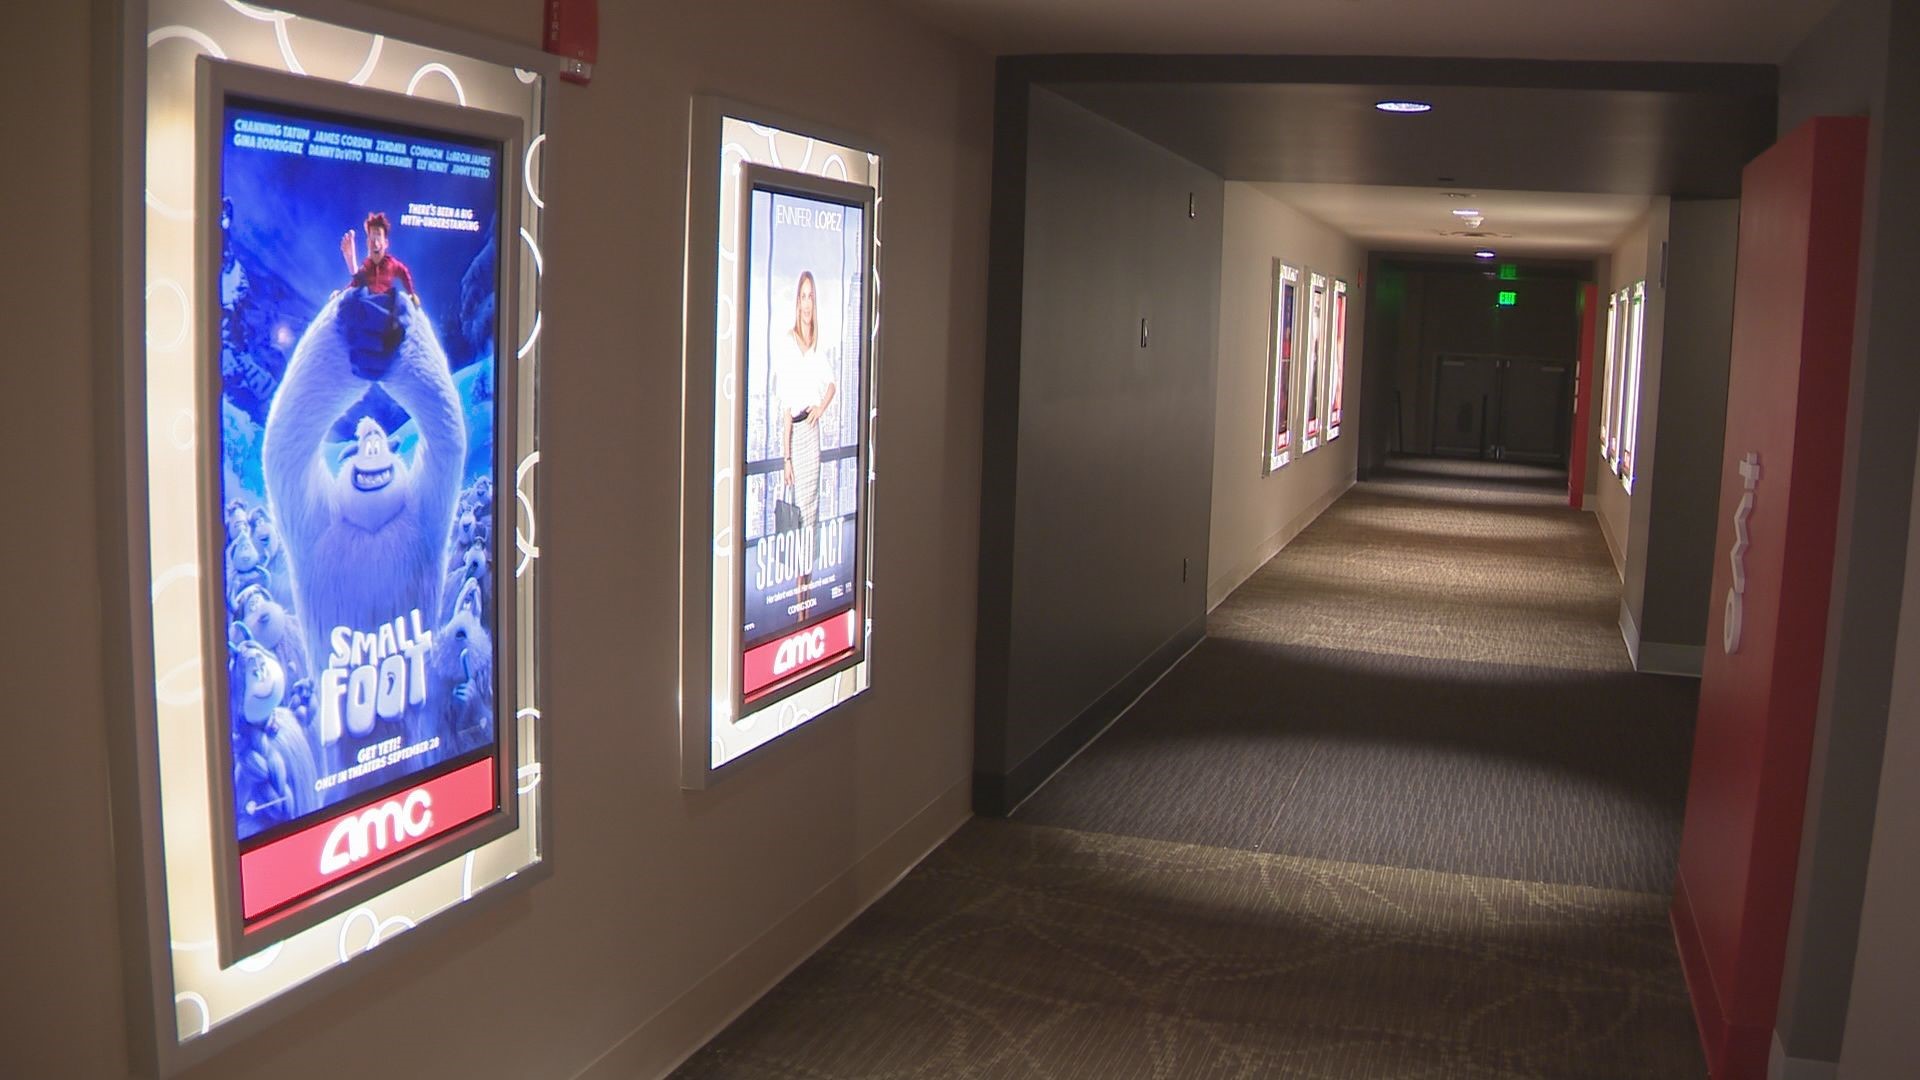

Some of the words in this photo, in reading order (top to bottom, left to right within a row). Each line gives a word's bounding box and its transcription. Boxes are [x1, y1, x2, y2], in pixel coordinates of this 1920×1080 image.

[234, 119, 282, 136] CHANNING
[282, 125, 310, 141] TATUM
[313, 130, 340, 145] JAMES
[341, 134, 373, 150] CORDEN
[375, 140, 407, 154] ZENDAYA
[410, 145, 444, 160] COMMON
[470, 154, 491, 167] JAMES
[234, 133, 256, 148] GINA
[256, 137, 304, 154] RODRIGUEZ
[308, 143, 335, 158] DANNY
[365, 151, 384, 165] YARA
[408, 202, 437, 216] THERE'S
[437, 205, 455, 218] BEEN
[460, 208, 474, 220] BIG
[815, 209, 842, 232] LOPEZ
[1500, 292, 1516, 305] EXIT
[756, 526, 814, 591] SECOND
[819, 517, 846, 571] ACT
[328, 608, 432, 669] SMALL
[321, 641, 432, 747] FOOT
[314, 773, 337, 792] ONLY
[337, 770, 348, 784] IN
[348, 756, 386, 780] THEATERS
[387, 741, 430, 765] SEPTEMBER
[357, 744, 377, 764] GET
